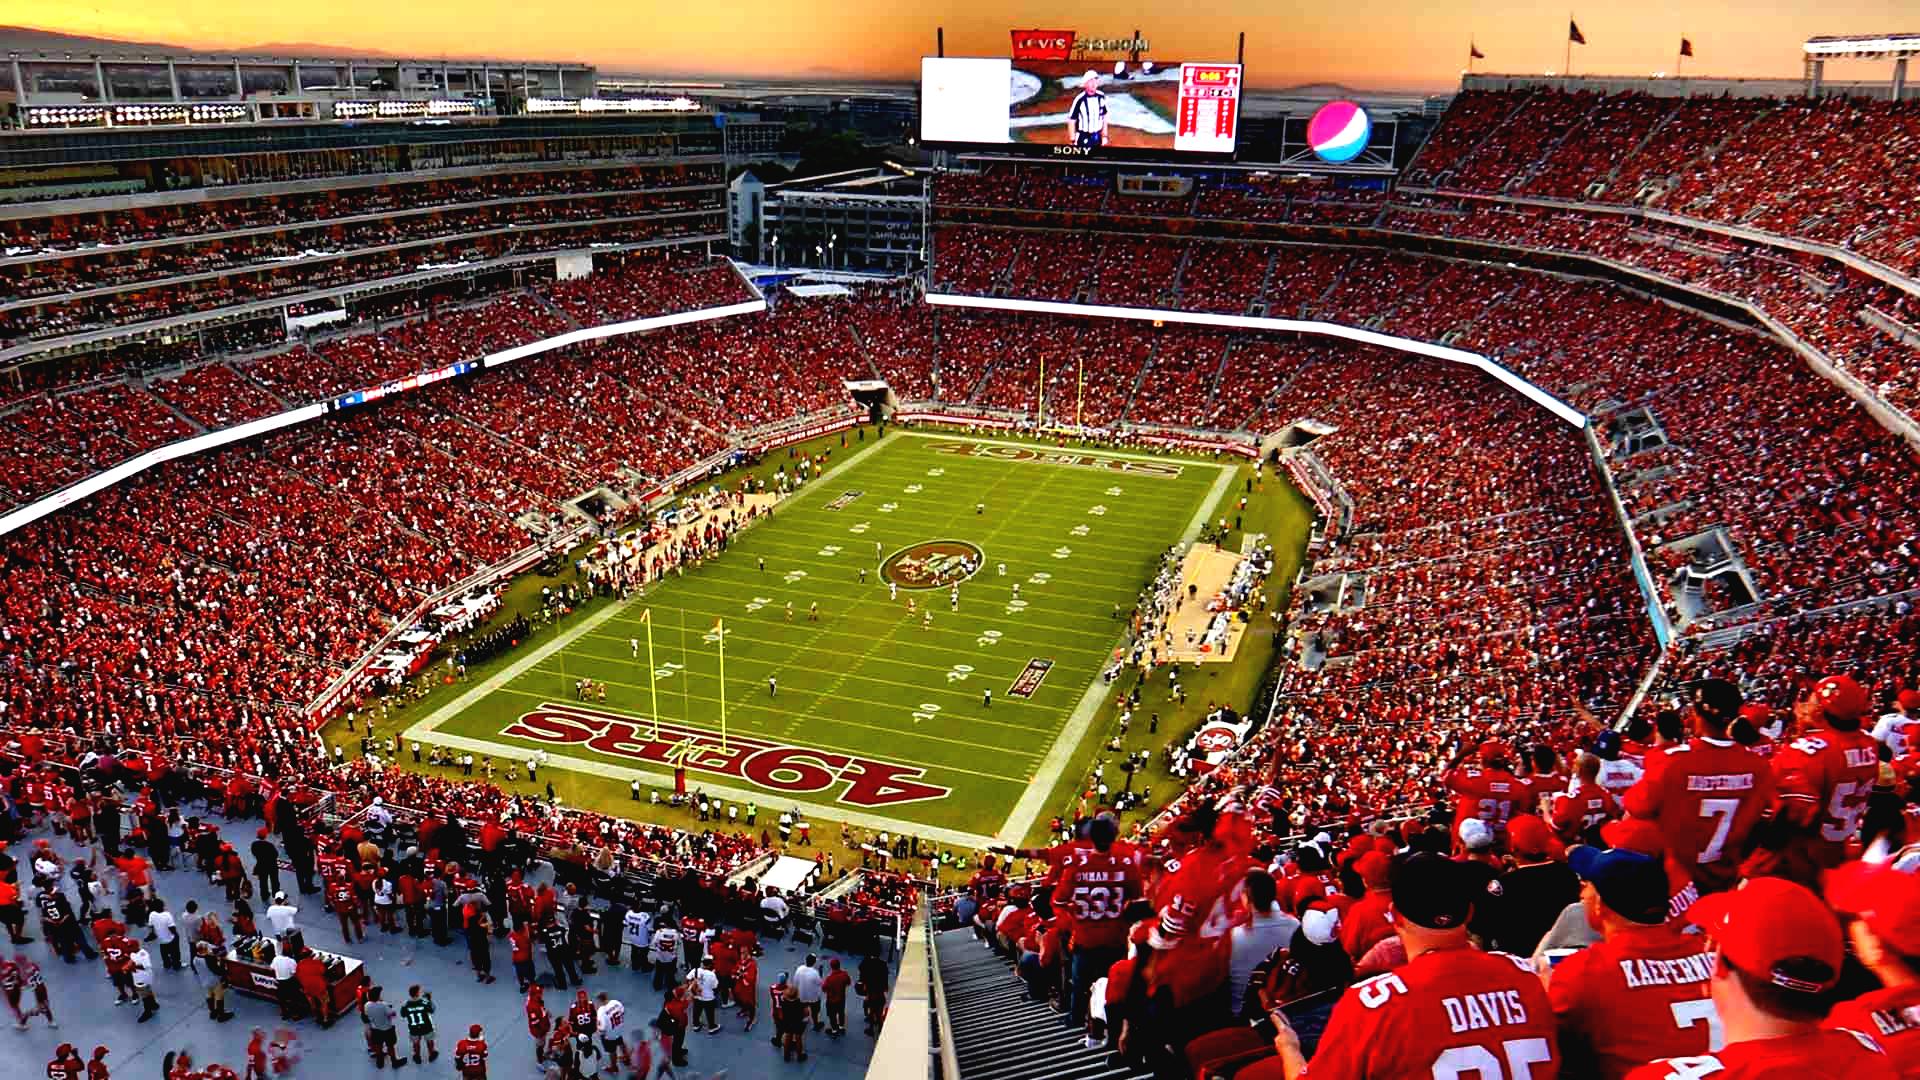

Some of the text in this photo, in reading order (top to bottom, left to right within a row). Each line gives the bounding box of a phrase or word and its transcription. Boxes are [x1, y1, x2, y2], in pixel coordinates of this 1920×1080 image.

[1053, 146, 1091, 156] SONY
[912, 703, 942, 724] 10
[499, 702, 952, 807] 49ERS
[1697, 798, 1740, 864] 7
[409, 1012, 425, 1026] 11
[576, 1013, 591, 1026] 85
[1441, 990, 1527, 1033] DAVIS
[1669, 998, 1725, 1053] 7
